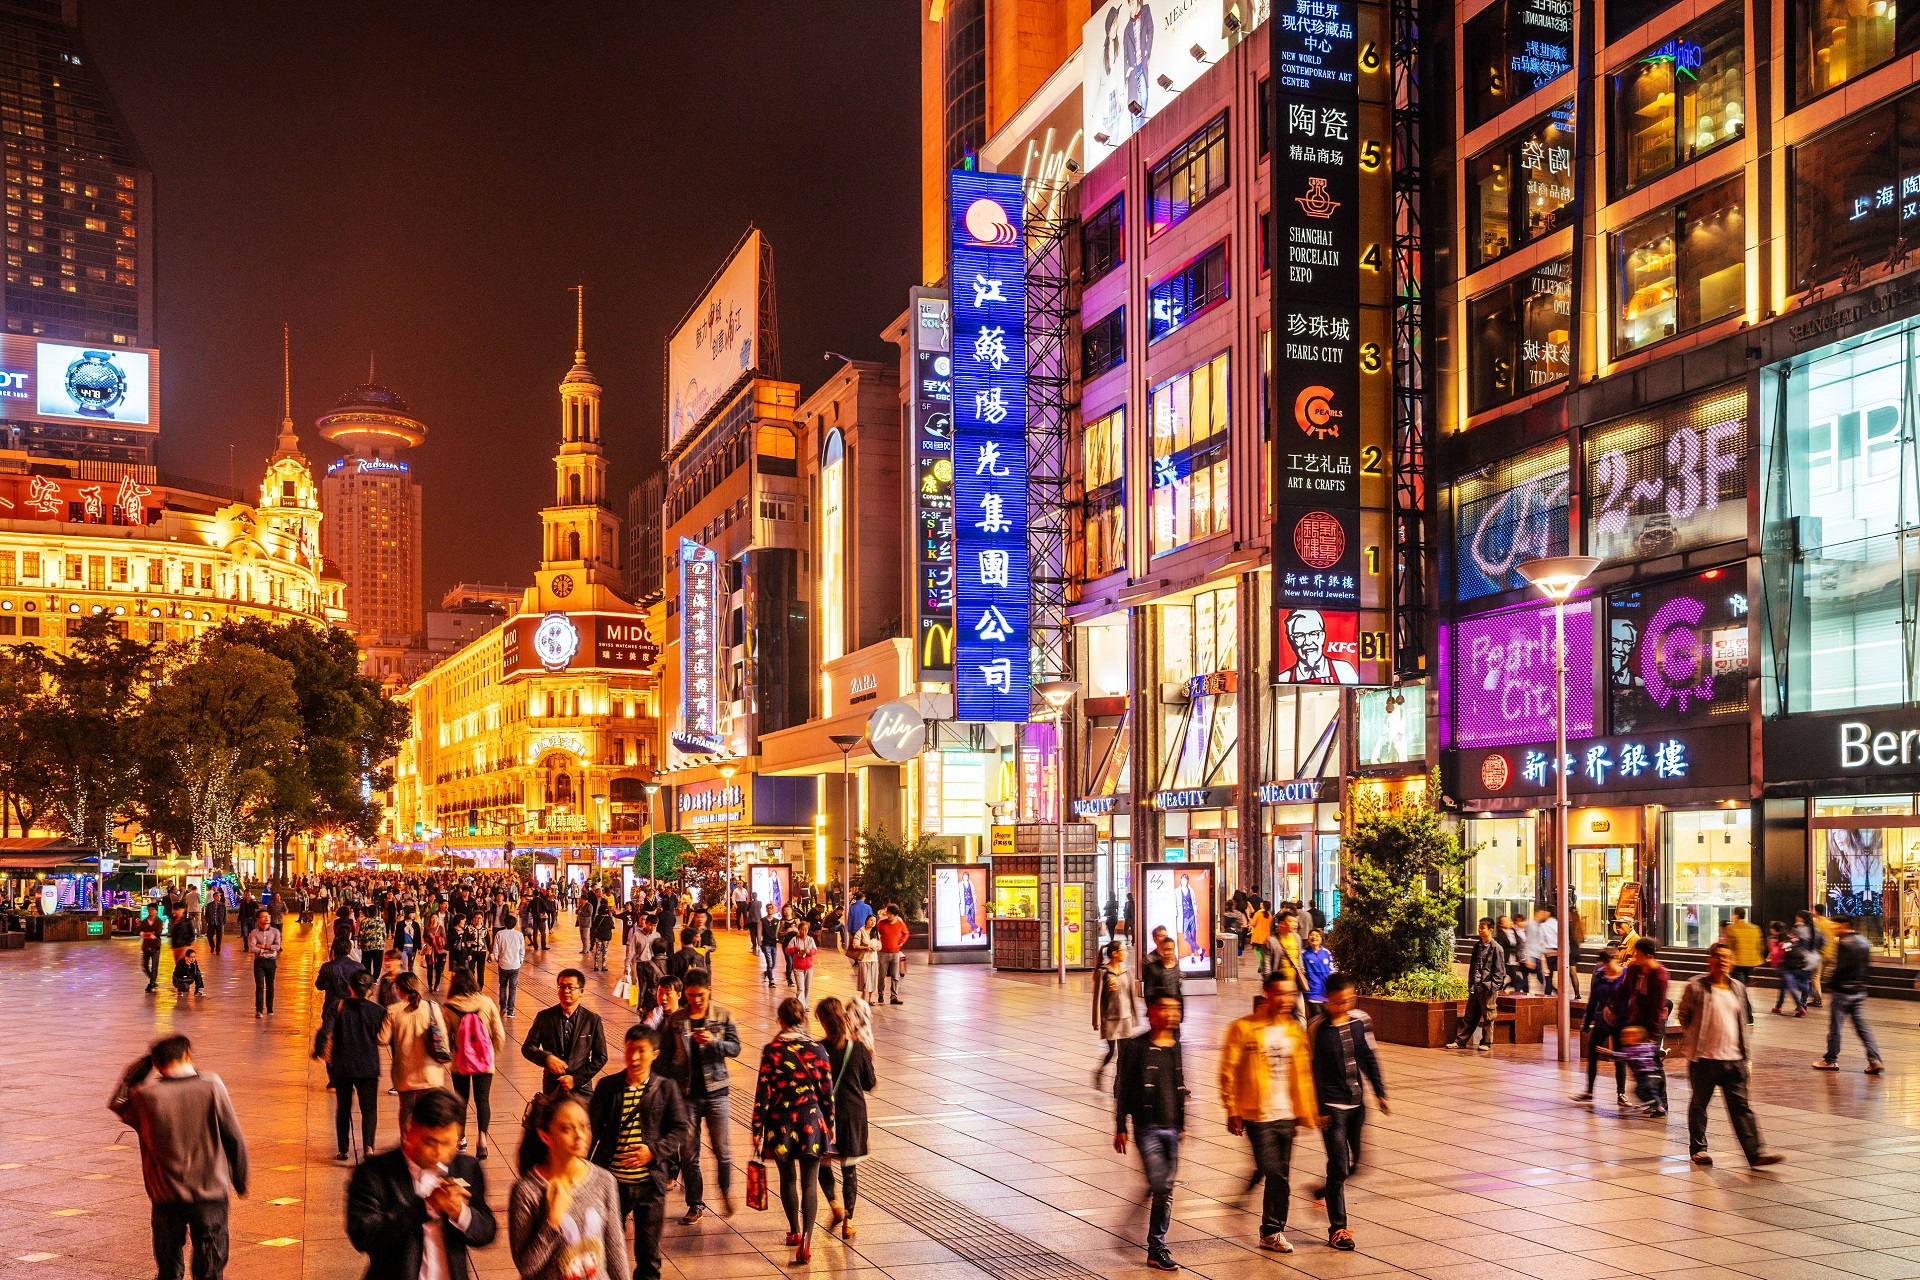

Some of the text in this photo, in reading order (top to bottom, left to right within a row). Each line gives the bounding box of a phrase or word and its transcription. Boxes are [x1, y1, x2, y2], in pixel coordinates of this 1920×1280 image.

[1296, 0, 1339, 19] 新世界
[1282, 14, 1352, 39] 现代珍藏品
[1304, 35, 1332, 53] 中心
[1281, 51, 1322, 65] NEW WORLD
[1361, 41, 1380, 70] 6
[1281, 64, 1352, 82] CONTEMPORARY ART
[1281, 76, 1310, 88] CENTER
[1289, 104, 1348, 141] 陶瓷
[1289, 145, 1344, 166] 精品商场
[1361, 141, 1381, 170] 5
[1289, 227, 1333, 246] SHANGHAI
[1289, 246, 1339, 267] PORCELAIN
[1361, 243, 1382, 272] 4
[1289, 266, 1312, 284] EXPO
[1288, 313, 1350, 341] 珍珠城
[1286, 343, 1343, 364] PEARLS CITY
[1361, 342, 1382, 374] 3
[357, 457, 399, 473] Radisson
[1287, 453, 1351, 474] 工艺礼品
[1361, 446, 1383, 475] 2
[973, 274, 1012, 693] 江蘇陽光集團公司
[1288, 477, 1345, 492] ART & CRAFTS
[1364, 546, 1380, 576] 1
[1284, 572, 1355, 589] 新世界銀樓
[1285, 589, 1355, 599] New World Jewelers
[1327, 641, 1357, 654] KFC
[1361, 631, 1388, 661] B1
[850, 673, 877, 695] ZARA
[873, 711, 925, 748] lily
[1841, 723, 1920, 768] Ber
[1157, 790, 1206, 808] ME&CITY
[1260, 782, 1319, 802] ME&CITY
[1074, 798, 1113, 815] ME&CITY
